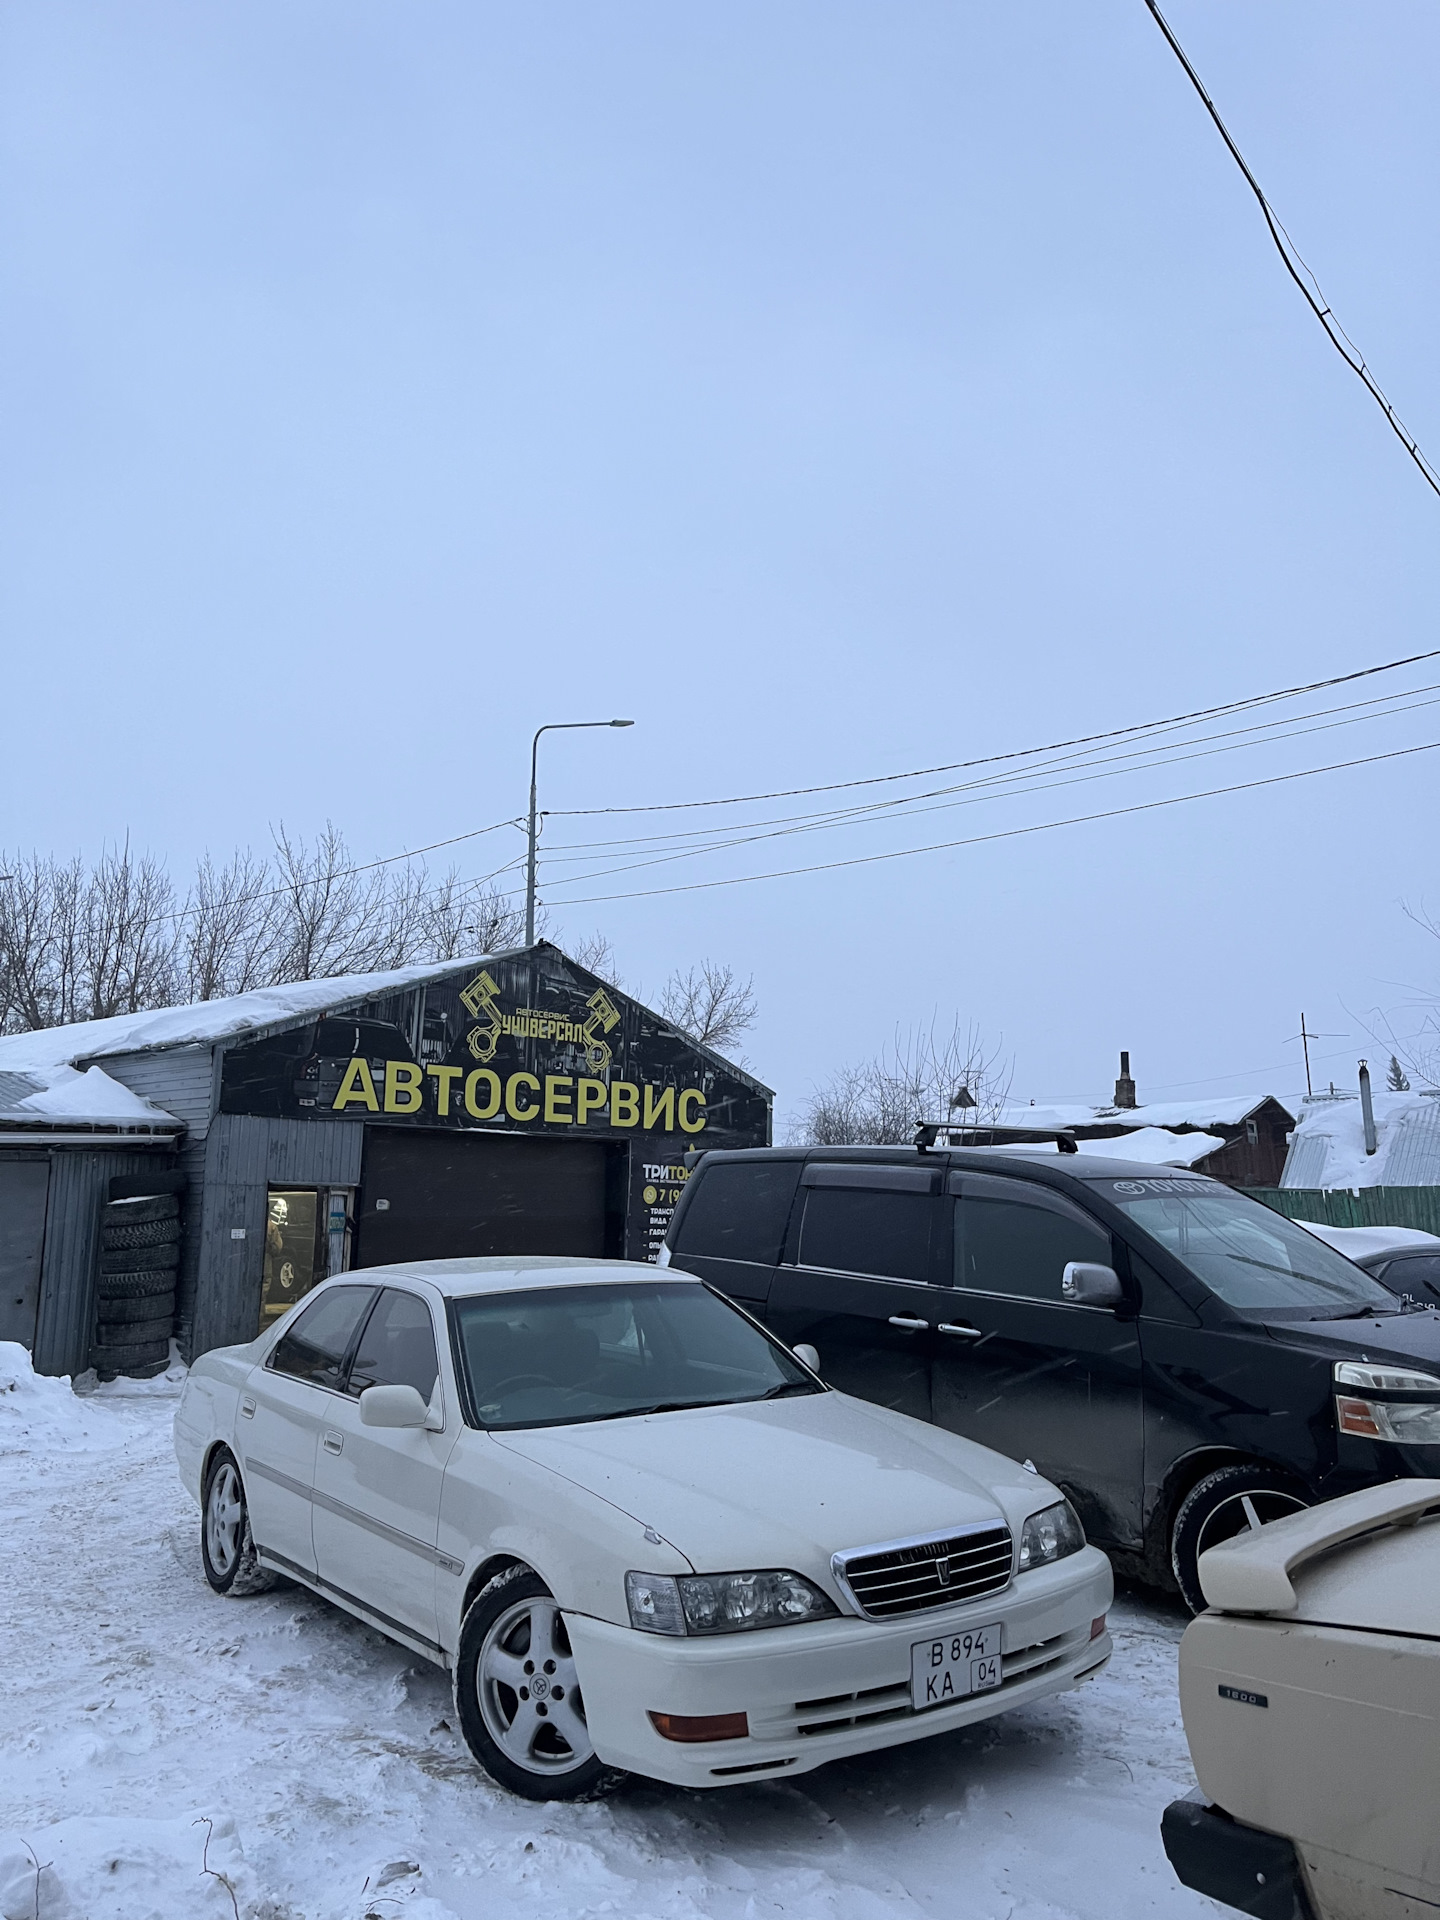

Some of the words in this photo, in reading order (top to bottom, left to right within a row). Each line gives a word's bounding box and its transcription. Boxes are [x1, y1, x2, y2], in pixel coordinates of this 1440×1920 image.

[515, 1007, 570, 1022] АВТОСЕРВИС
[502, 1014, 583, 1043] УНИВЕРСАЛ
[332, 1057, 707, 1133] АВТОСЕРВИС
[659, 1189, 666, 1201] 7
[669, 1189, 682, 1204] (9
[1136, 1179, 1216, 1194] TOYOTA
[951, 1632, 984, 1661] 894
[979, 1659, 996, 1681] 04
[927, 1671, 954, 1701] КА
[1226, 1690, 1257, 1703] 1600
